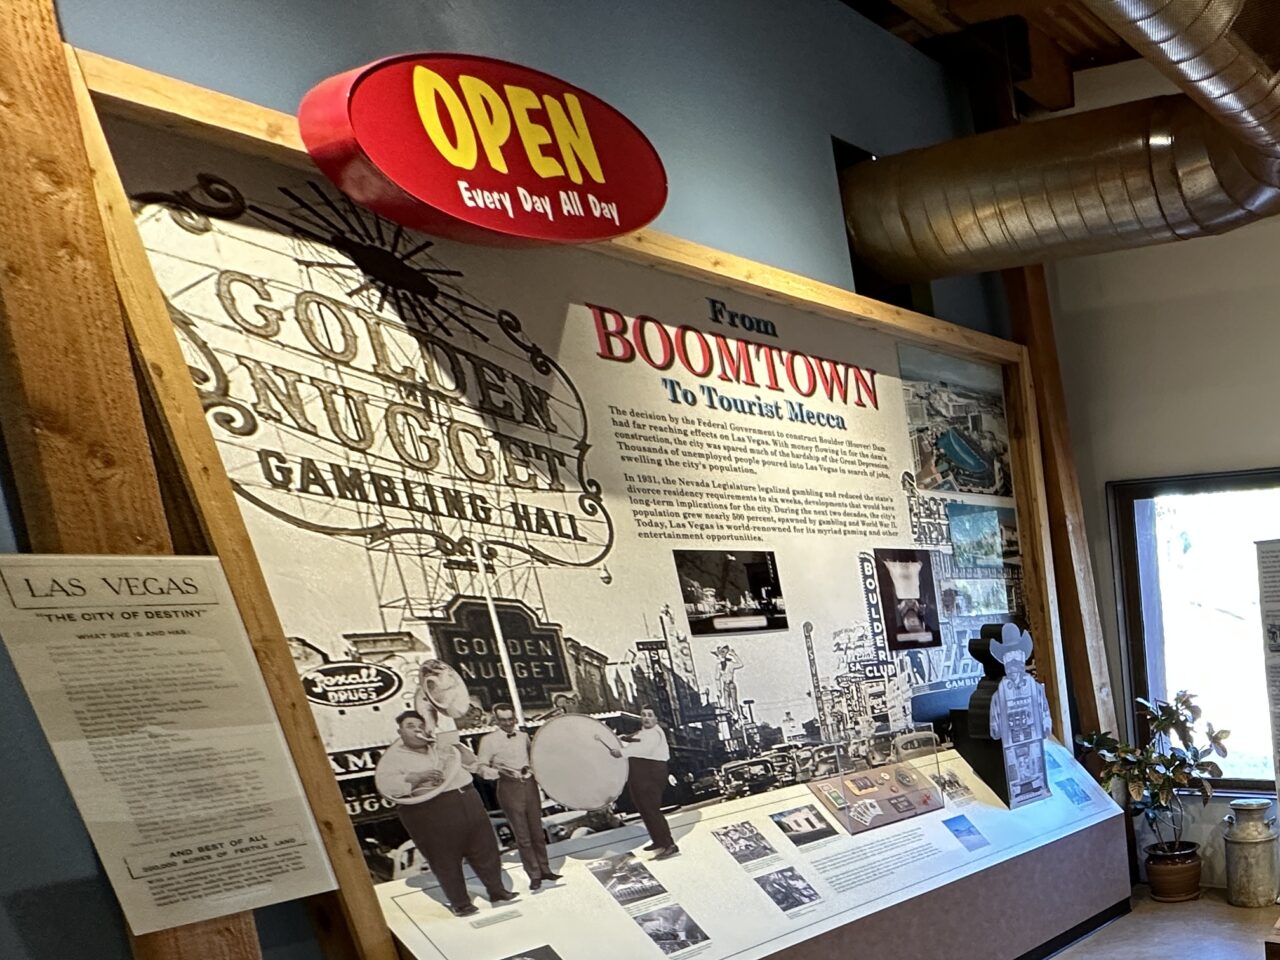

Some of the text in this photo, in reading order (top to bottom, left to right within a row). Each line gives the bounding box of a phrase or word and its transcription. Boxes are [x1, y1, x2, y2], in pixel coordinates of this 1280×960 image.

[412, 64, 606, 184] OPEN
[460, 181, 621, 226] Every Day All Day
[705, 296, 778, 337] From
[214, 270, 558, 433] GOLDEN
[585, 303, 880, 411] BOOMTOWN
[661, 377, 848, 431] To Tourist Mecca
[238, 356, 567, 492] NUGGET
[611, 418, 630, 427] had
[633, 421, 646, 429] far
[649, 425, 689, 436] reaching
[691, 429, 718, 439] effects
[731, 434, 745, 442] Las
[747, 436, 770, 446] Vegas.
[772, 440, 789, 448] With
[791, 444, 813, 452] money
[616, 441, 669, 454] Thousands
[682, 451, 732, 461] unemployed
[734, 457, 760, 465] people
[762, 460, 788, 468] poured
[790, 461, 804, 469] into
[805, 463, 818, 471] Las
[819, 465, 838, 474] Vegas
[621, 455, 757, 475] swelling the city's population.
[257, 448, 588, 543] GAMBLING HALL
[624, 473, 635, 481] In
[637, 474, 660, 485] 1931,
[662, 477, 676, 485] the
[678, 478, 710, 487] Nevada
[712, 481, 756, 491] Legislature
[757, 485, 790, 494] legalized
[792, 489, 823, 498] gambling
[629, 496, 674, 506] long-term
[676, 499, 728, 510] implications
[774, 506, 799, 515] During
[635, 519, 667, 528] Today,
[688, 521, 714, 530] Vegas
[726, 524, 792, 532] world-renowned
[638, 531, 704, 539] entertainment
[24, 576, 199, 599] LAS VEGAS
[36, 609, 208, 623] "THE CITY OF DESTINY"
[862, 561, 888, 661] BOULDER
[76, 632, 107, 641] WHAT
[146, 629, 166, 638] AND
[307, 668, 382, 693] Rexall
[865, 664, 896, 677] CLUB
[327, 688, 378, 704] DRUGS
[168, 847, 194, 858] AND
[229, 838, 244, 847] OF
[248, 834, 268, 843] ALL
